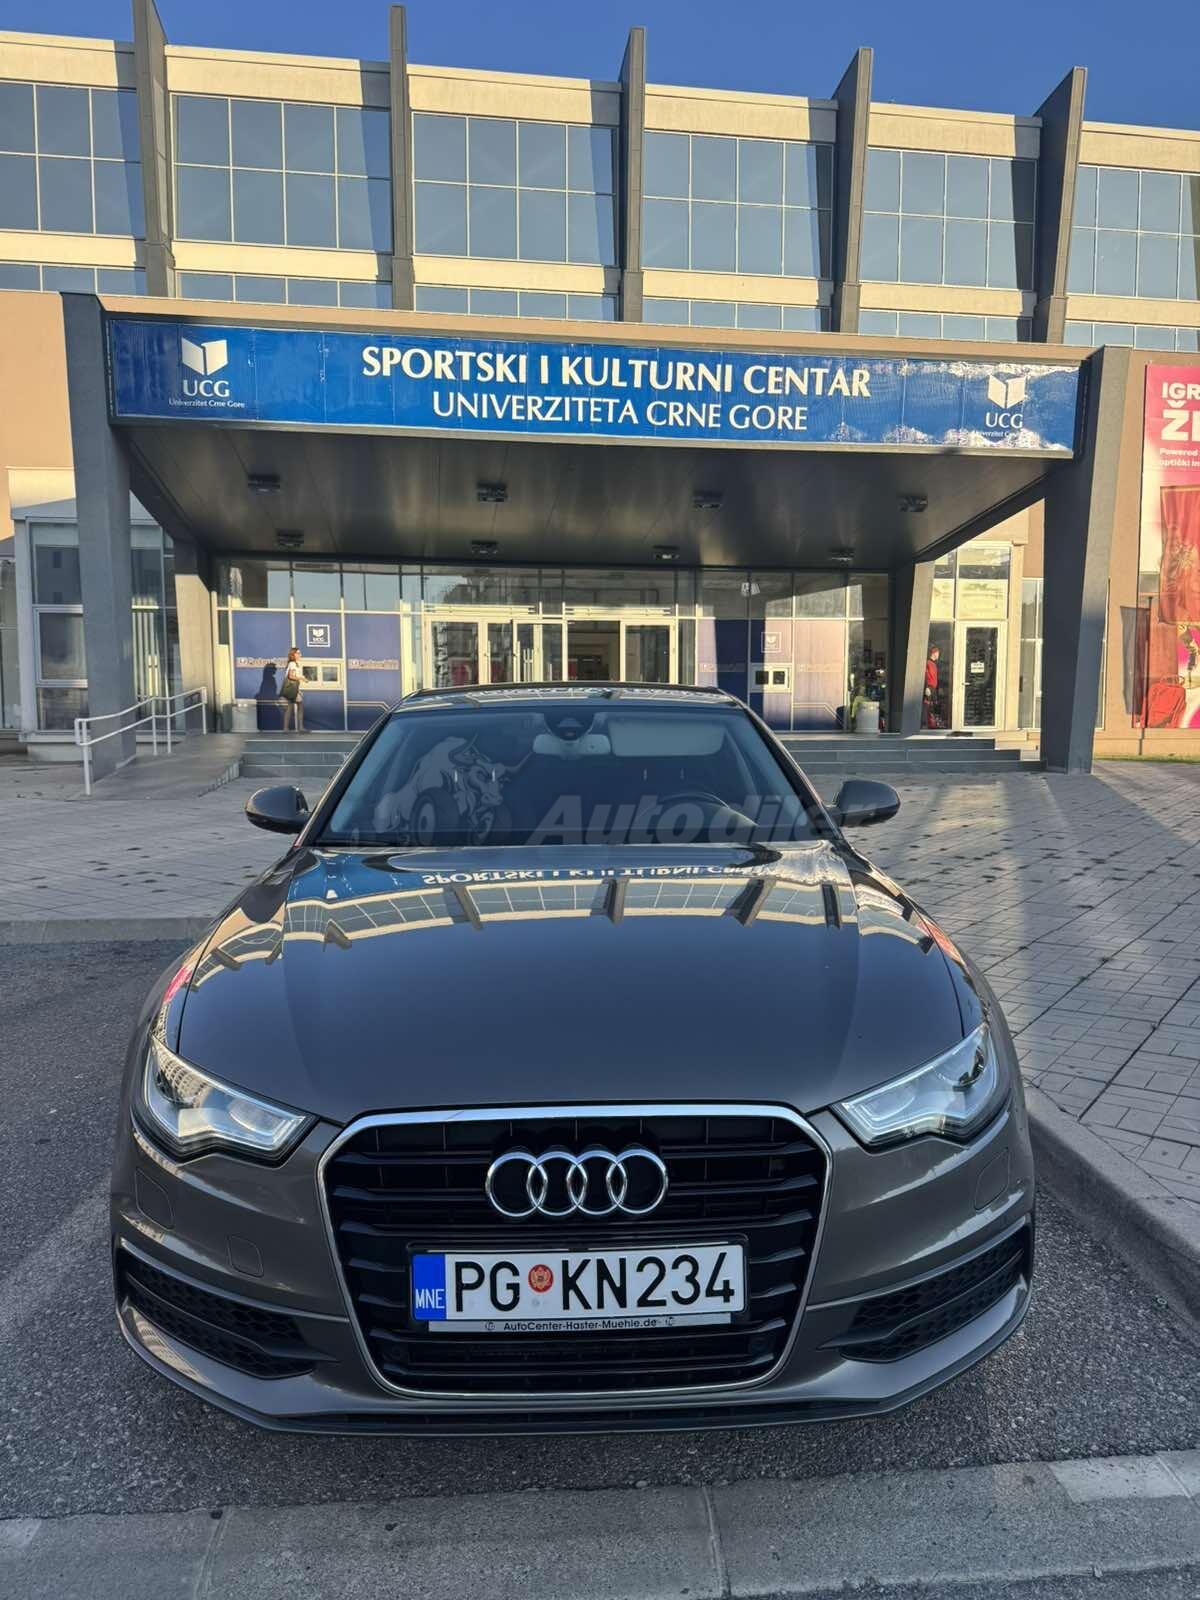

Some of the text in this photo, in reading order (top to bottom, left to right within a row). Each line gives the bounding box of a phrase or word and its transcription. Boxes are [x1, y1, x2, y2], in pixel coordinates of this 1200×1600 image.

[362, 346, 871, 398] SPORTSKI I KULTURNI CENTAR
[183, 379, 230, 397] UCG
[1161, 382, 1200, 400] IGR
[432, 391, 808, 431] UNIVERZITETA CRNE GORE
[985, 412, 1023, 429] UCG
[454, 1251, 735, 1312] PG KN234
[415, 1289, 446, 1309] MNE
